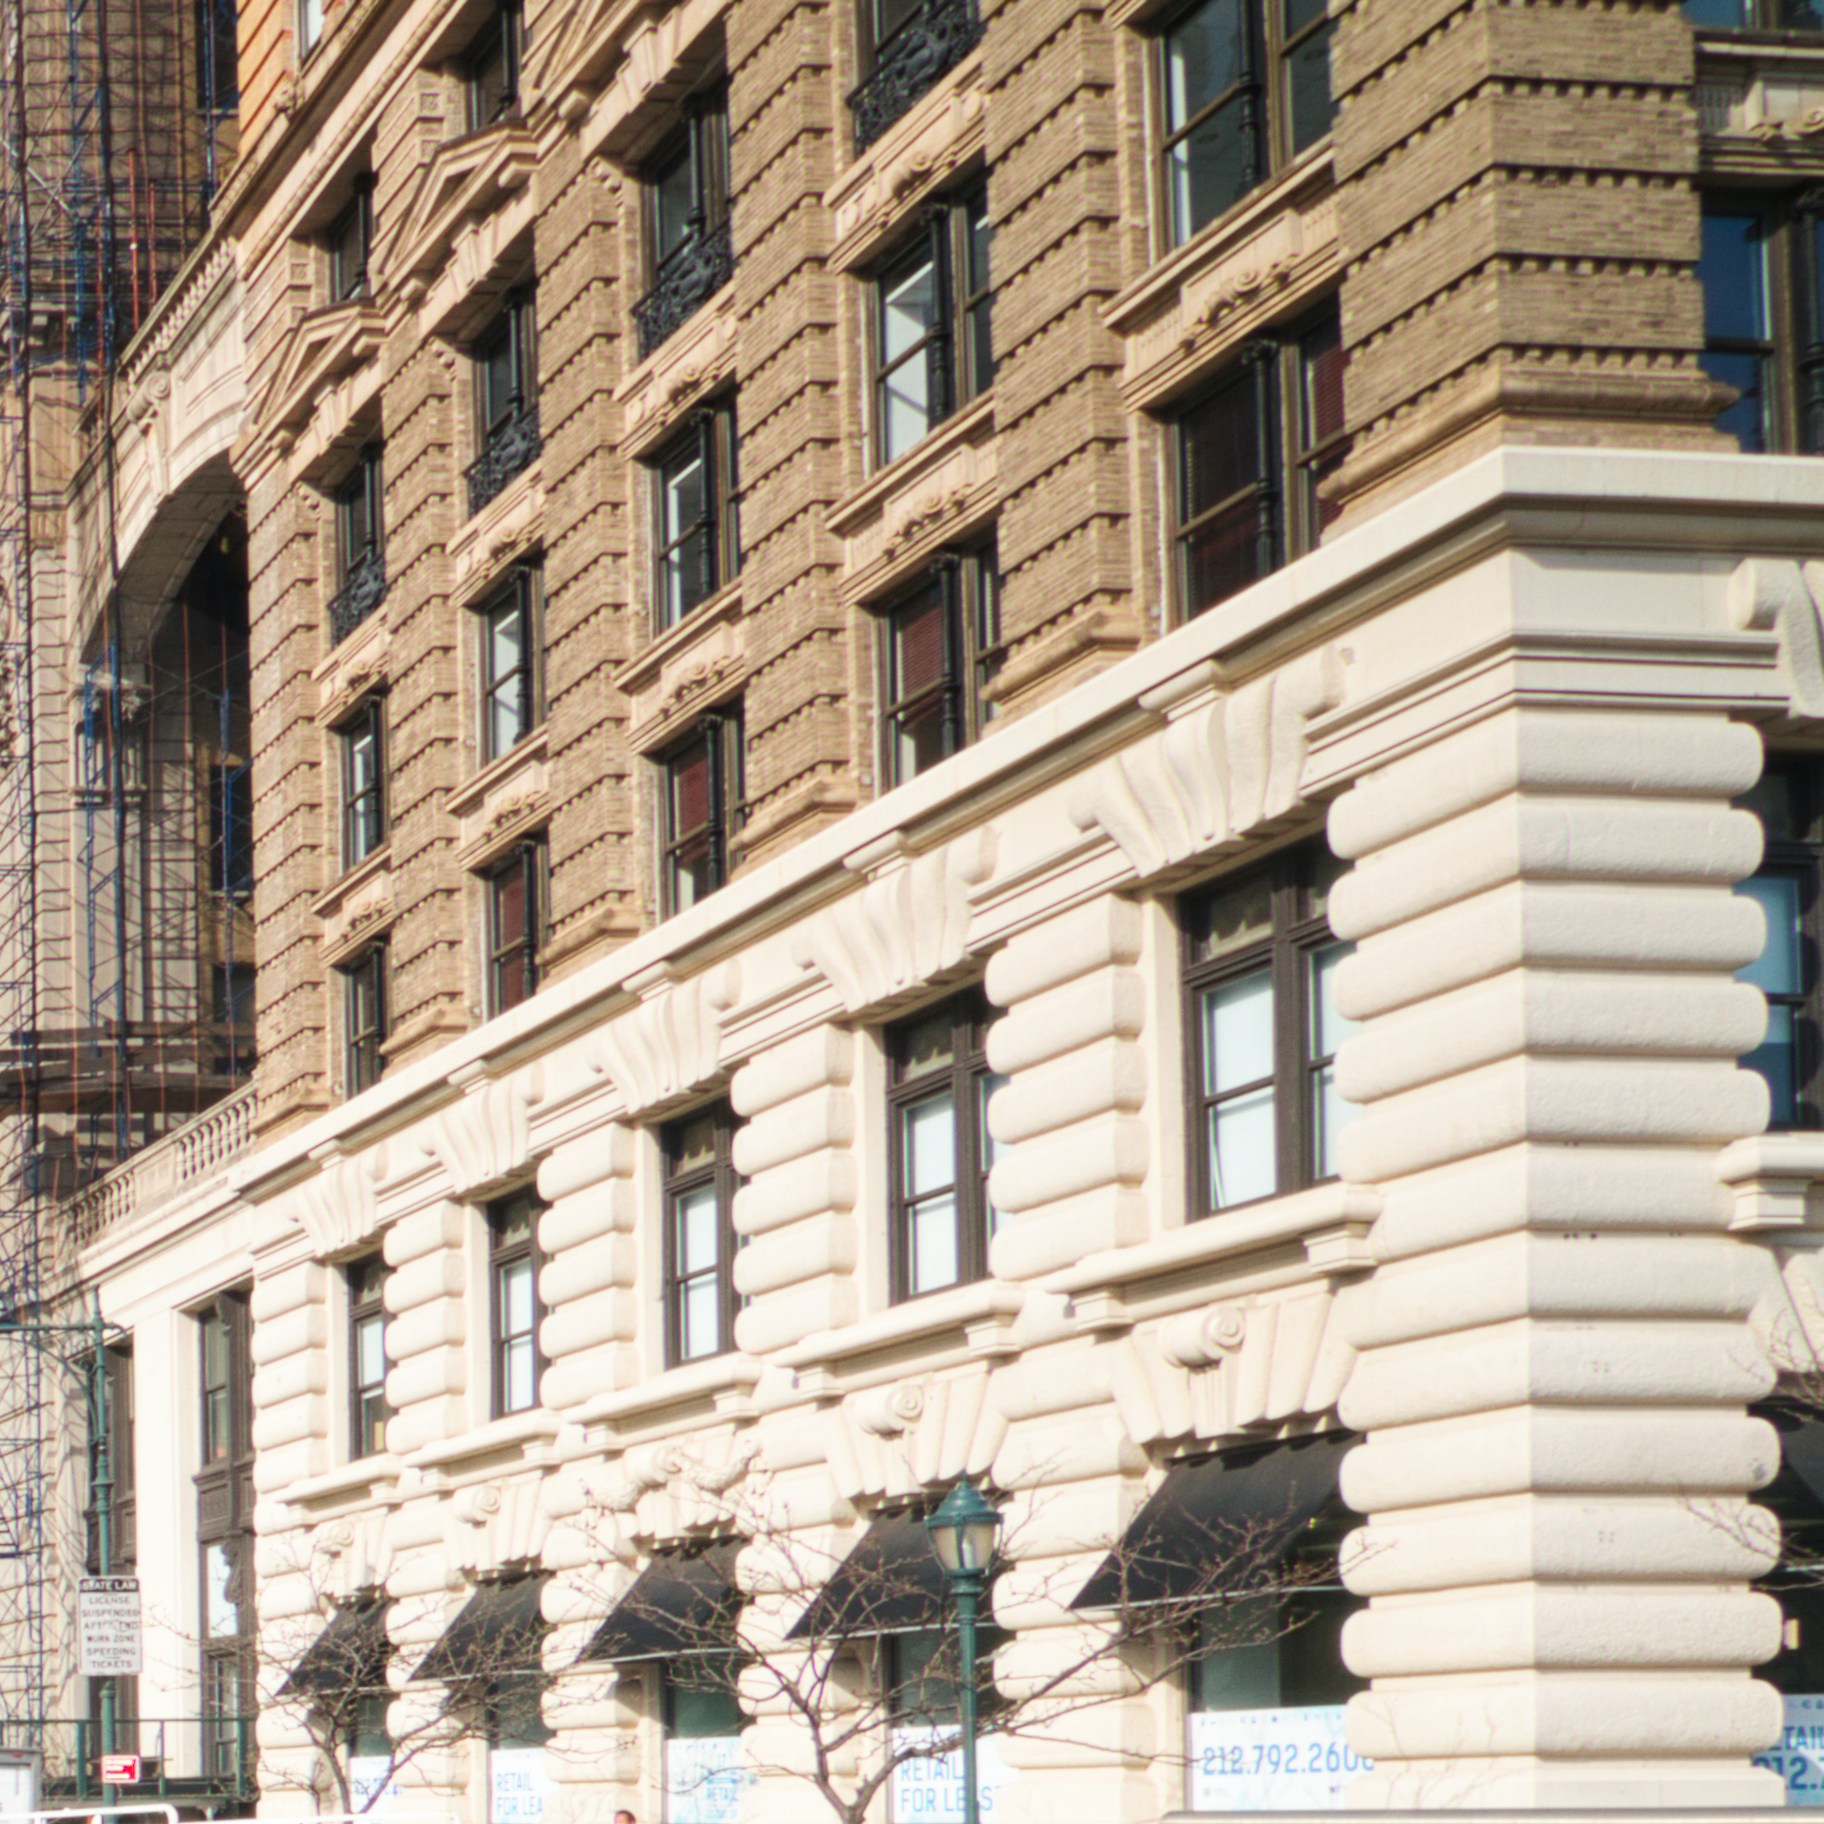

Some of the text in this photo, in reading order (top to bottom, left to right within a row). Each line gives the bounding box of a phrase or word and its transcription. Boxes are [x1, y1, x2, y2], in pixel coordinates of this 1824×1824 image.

[114, 1579, 138, 1590] LAW
[88, 1596, 131, 1605] LICENSE
[82, 1608, 139, 1618] SUSPENDED
[113, 1634, 136, 1643] ZONE
[87, 1647, 137, 1656] SPEEDING
[91, 1660, 133, 1669] TICKETS
[496, 1772, 532, 1792] RETAIL
[900, 1788, 936, 1812] FOR
[496, 1796, 519, 1816] FOR
